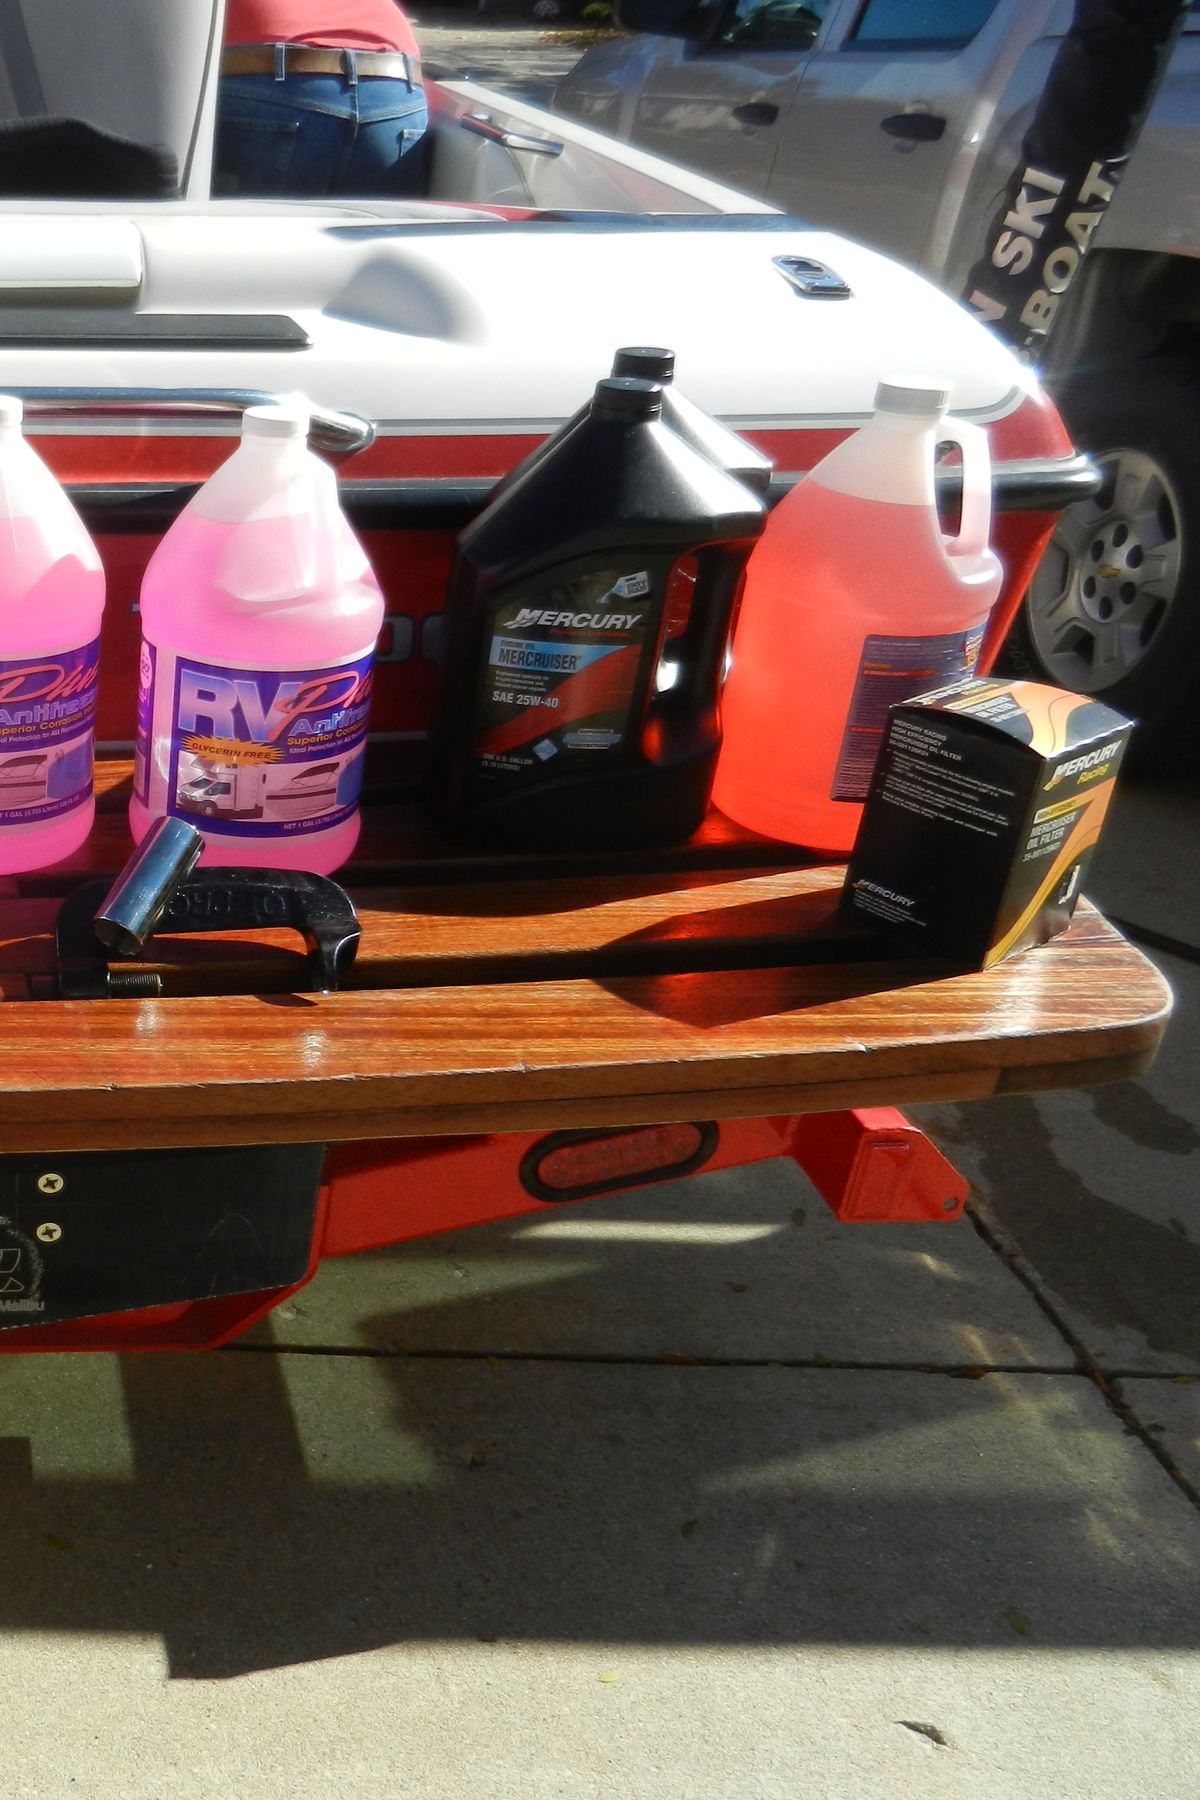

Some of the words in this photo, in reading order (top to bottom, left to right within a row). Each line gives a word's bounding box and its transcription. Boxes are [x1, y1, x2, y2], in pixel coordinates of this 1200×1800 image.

[992, 167, 1066, 276] SKI
[1019, 161, 1116, 335] BOAT
[503, 608, 642, 630] MERCURY
[498, 648, 578, 670] MERCRUISER
[178, 668, 304, 743] RV
[492, 690, 514, 704] SAE
[516, 694, 560, 708] 25W-40
[9, 733, 41, 742] Protection
[287, 733, 333, 746] Superior
[923, 729, 947, 741] RACING
[192, 743, 241, 757] GLYCERIN
[243, 751, 271, 759] FREE
[289, 746, 306, 754] Ideal
[929, 745, 939, 754] OIL
[940, 749, 962, 761] FILTER
[1043, 740, 1122, 791] MERCURY
[1026, 838, 1038, 850] OIL
[1040, 826, 1065, 844] FILTER
[852, 879, 915, 907] MERCURY
